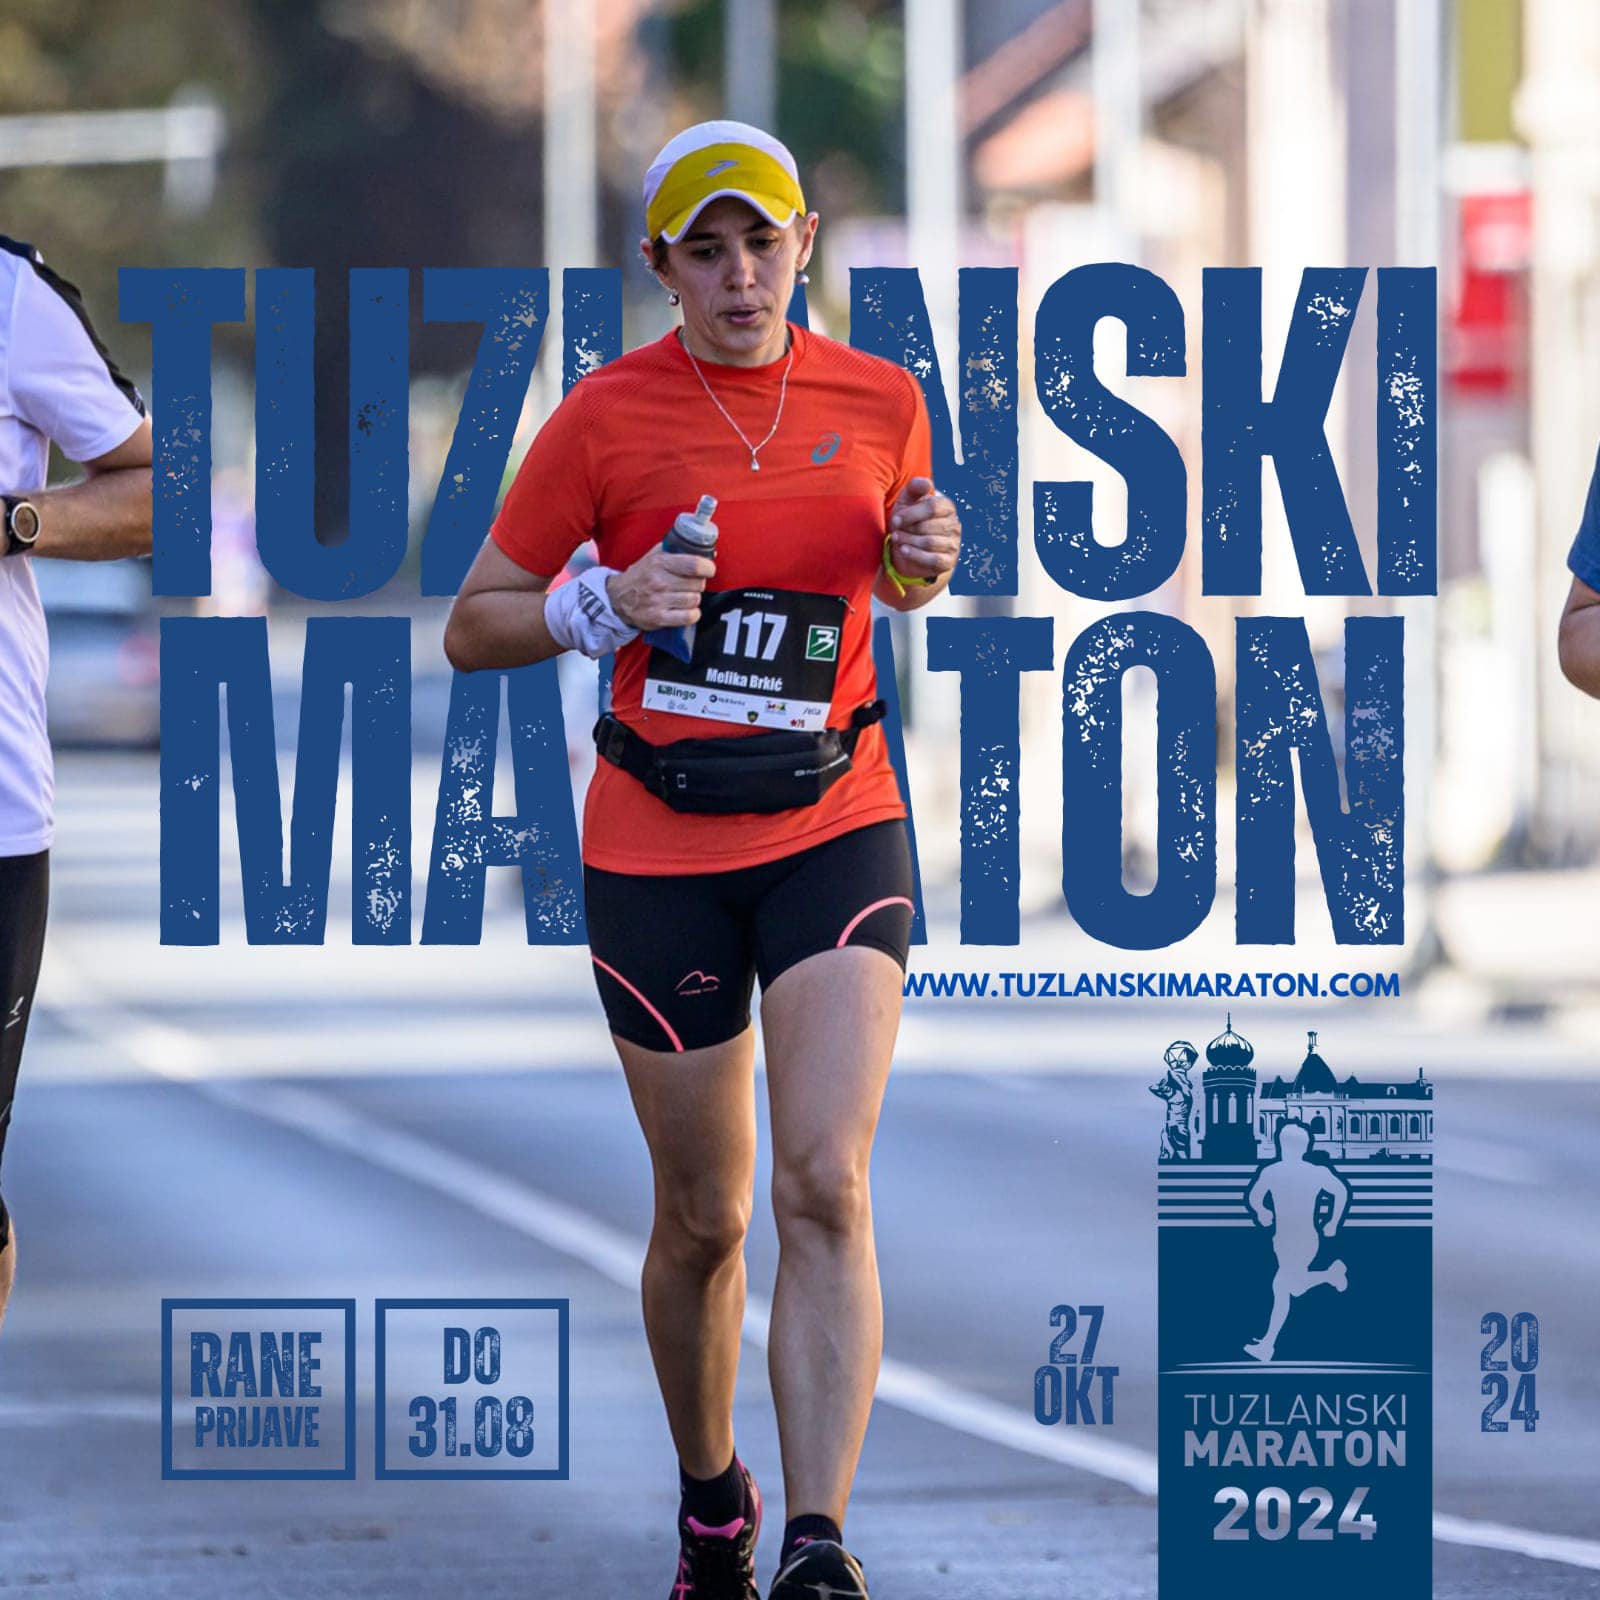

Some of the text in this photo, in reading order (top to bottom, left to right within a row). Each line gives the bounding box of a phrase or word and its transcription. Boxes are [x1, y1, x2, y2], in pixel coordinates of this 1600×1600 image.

[720, 608, 788, 661] 117
[705, 667, 783, 692] Melika Brkić
[665, 685, 697, 701] Bingo
